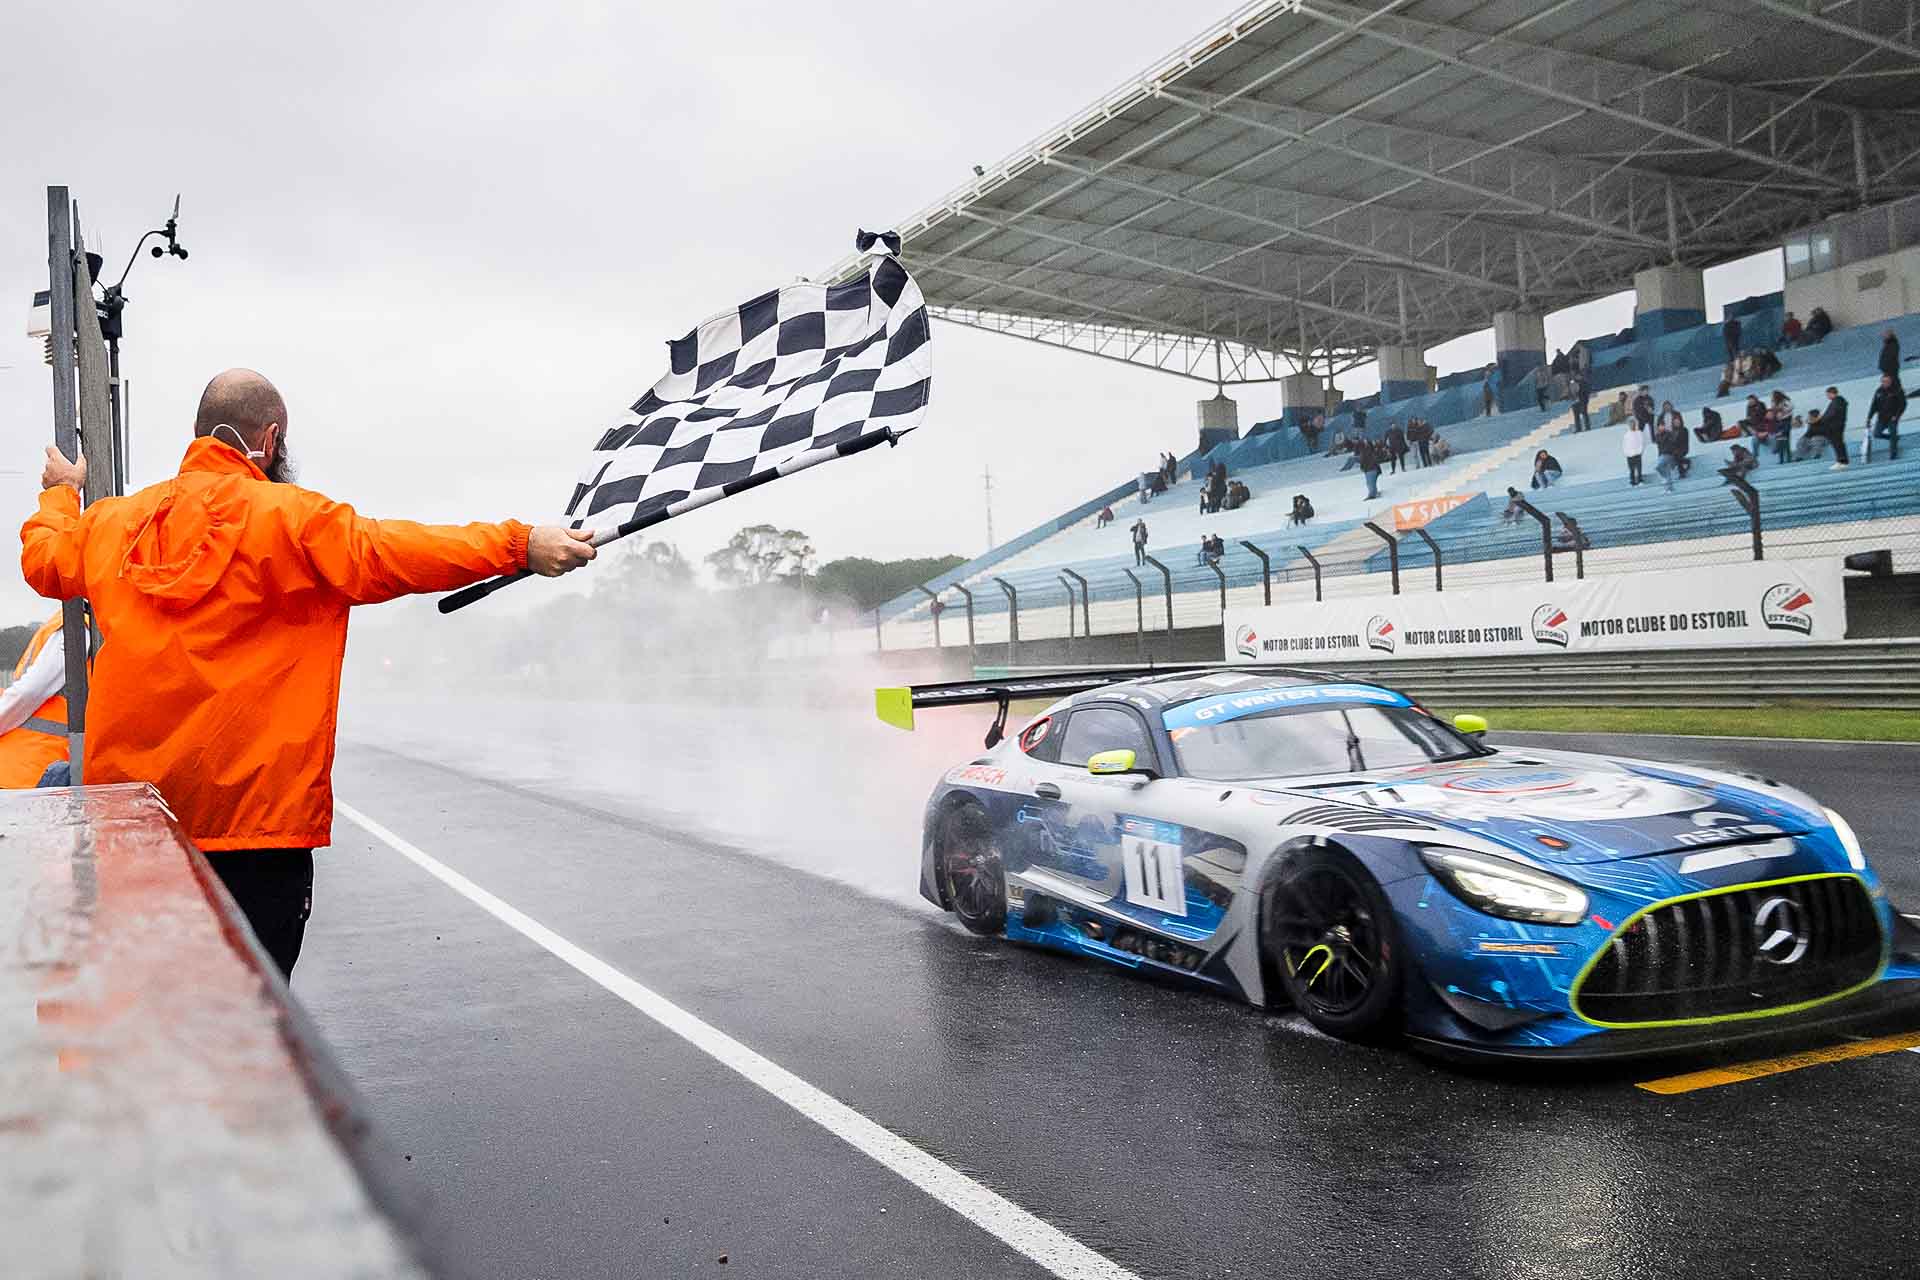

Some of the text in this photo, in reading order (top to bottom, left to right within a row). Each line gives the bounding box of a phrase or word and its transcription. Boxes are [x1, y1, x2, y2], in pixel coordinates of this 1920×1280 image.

[1580, 610, 1749, 637] MOTOR CLUBE DO ESTORIL
[1767, 613, 1808, 626] ESTORIL
[1263, 638, 1289, 652] MOTOR
[1290, 637, 1313, 651] CLUBE
[1315, 637, 1326, 650] DO
[1327, 634, 1360, 649] ESTORIL
[1404, 626, 1523, 645] MOTOR CLUBE DO ESTORIL
[1195, 703, 1226, 720] GT
[1231, 688, 1317, 709] WINTER
[1355, 787, 1406, 806] 11
[1135, 842, 1166, 900] 11
